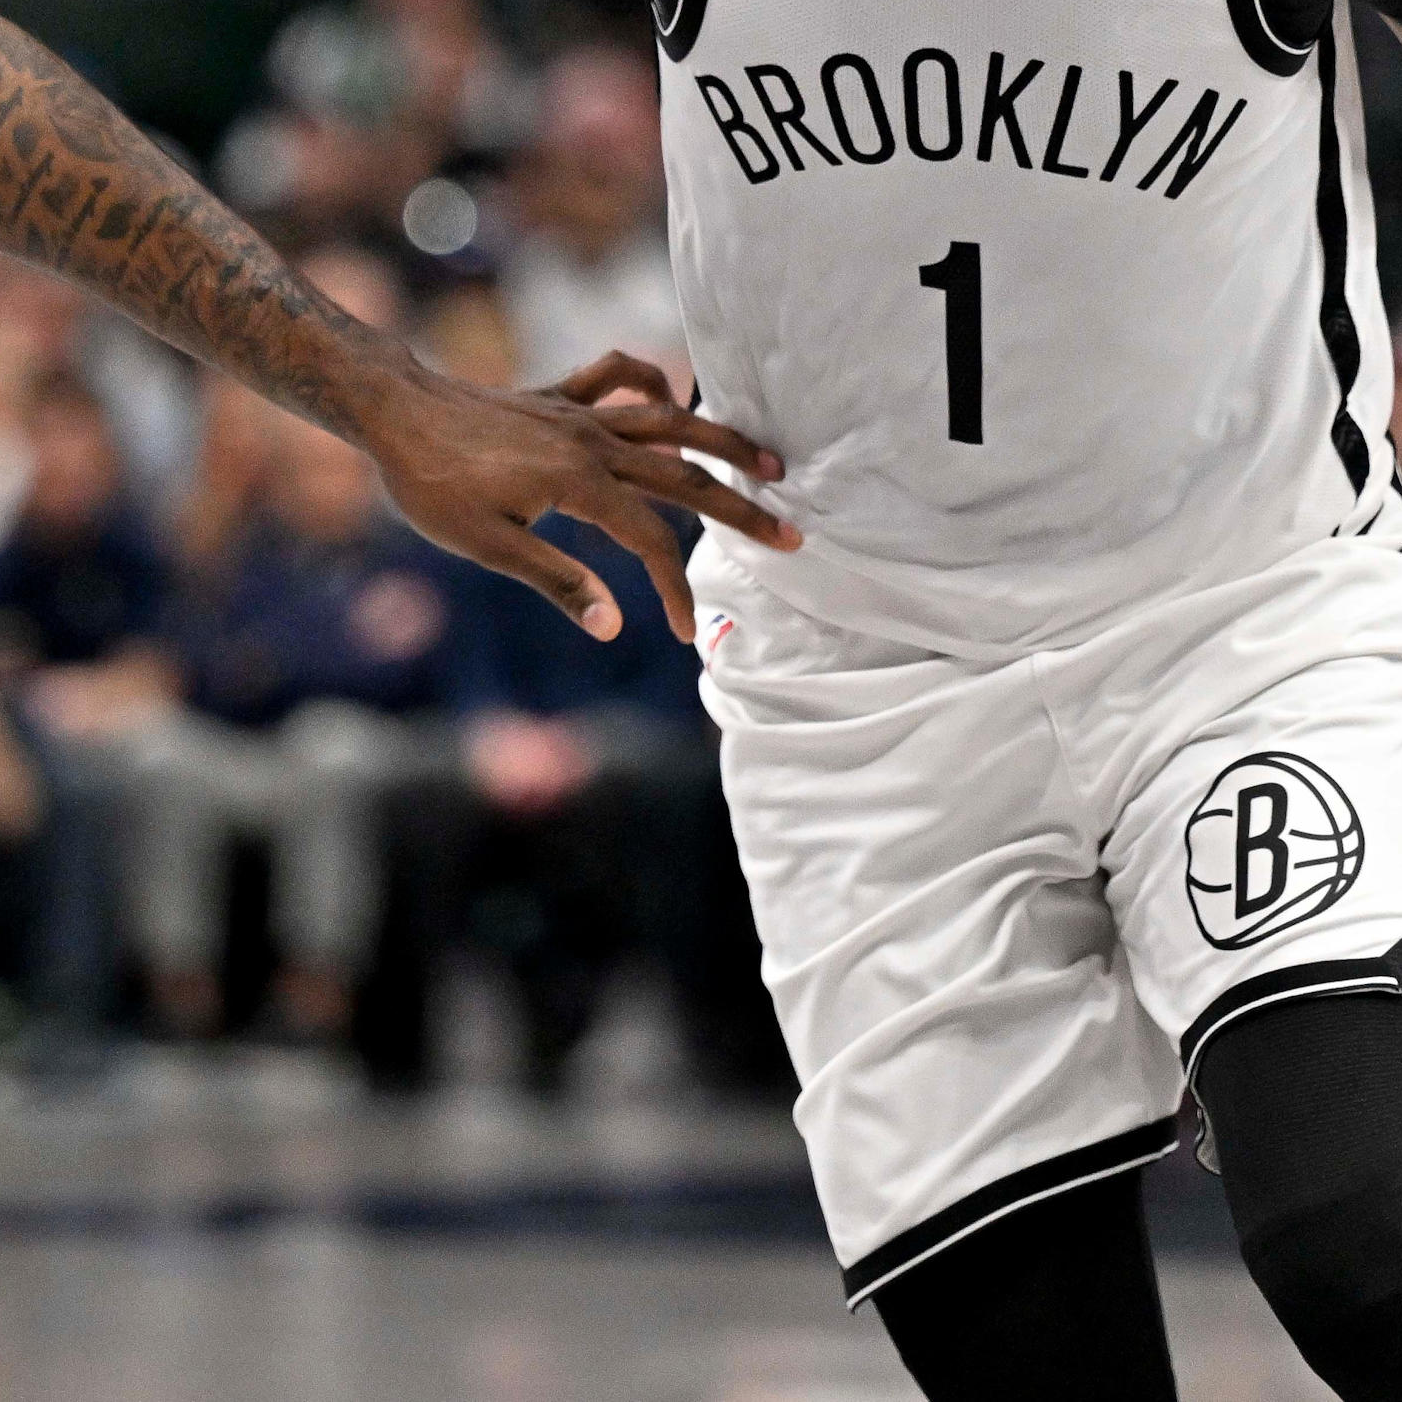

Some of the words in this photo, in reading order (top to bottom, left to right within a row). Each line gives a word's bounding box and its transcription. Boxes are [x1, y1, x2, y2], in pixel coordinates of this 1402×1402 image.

[695, 47, 1248, 200] BROOKLYN
[918, 240, 984, 446] 1
[1235, 782, 1289, 920] B
